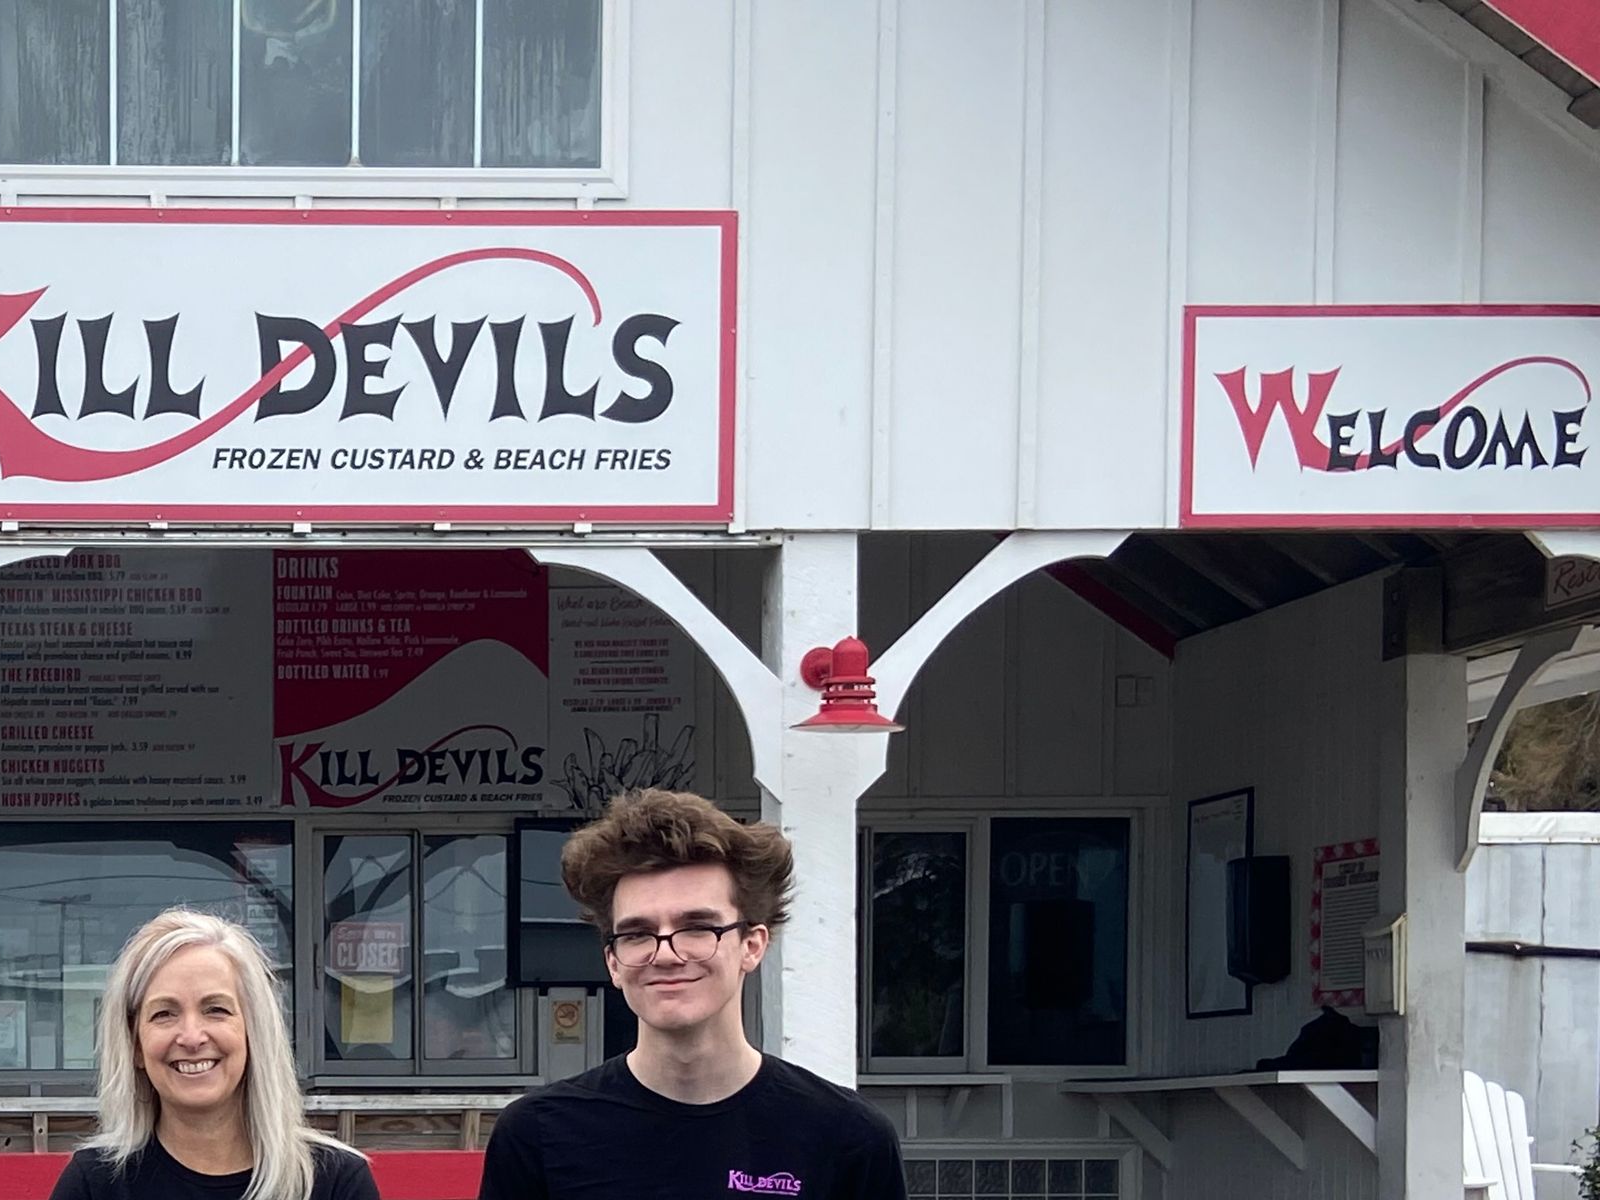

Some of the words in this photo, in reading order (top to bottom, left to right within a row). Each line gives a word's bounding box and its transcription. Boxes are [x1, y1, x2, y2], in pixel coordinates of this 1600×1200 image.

[254, 310, 682, 424] DEVILS
[1213, 365, 1590, 473] WELCOME
[212, 448, 321, 470] FROZEN
[332, 448, 455, 470] CUSTARD
[465, 448, 485, 470] &
[494, 448, 585, 470] BEACH
[595, 448, 672, 470] FRIES
[64, 554, 95, 568] PORK
[97, 554, 119, 568] BBQ
[277, 557, 339, 579] DRINKS
[1554, 560, 1600, 596] Rest
[52, 588, 122, 603] MISSISSIPPI
[127, 588, 175, 603] CHICKEN
[179, 588, 202, 603] BBQ
[277, 585, 332, 600] FOUNTAIN
[1, 622, 35, 636] TEXAS
[40, 622, 76, 636] STEAK
[90, 622, 133, 636] CHEESE
[277, 619, 328, 634] BOTTLED
[332, 619, 374, 634] DRINKS
[390, 619, 411, 634] TEA
[1, 667, 22, 681] THE
[26, 667, 81, 681] FREEBIRD
[277, 665, 329, 679] BOTTLED
[332, 665, 370, 679] WATER
[1, 726, 48, 740] GRILLED
[52, 726, 94, 740] CHEESE
[1, 759, 49, 773] CHICKEN
[53, 759, 104, 773] NUGGETS
[280, 742, 380, 807] KILL
[396, 747, 546, 787] DEVILS
[2, 792, 31, 806] HUSH
[34, 792, 80, 806] PUPPIES
[382, 793, 421, 803] FROZEN
[424, 793, 467, 803] CUSTARD
[480, 793, 513, 803] BEACH
[515, 793, 543, 803] FRIES
[337, 942, 399, 967] CLOSED
[728, 1169, 754, 1191] KILL
[758, 1175, 802, 1192] DEVILS
